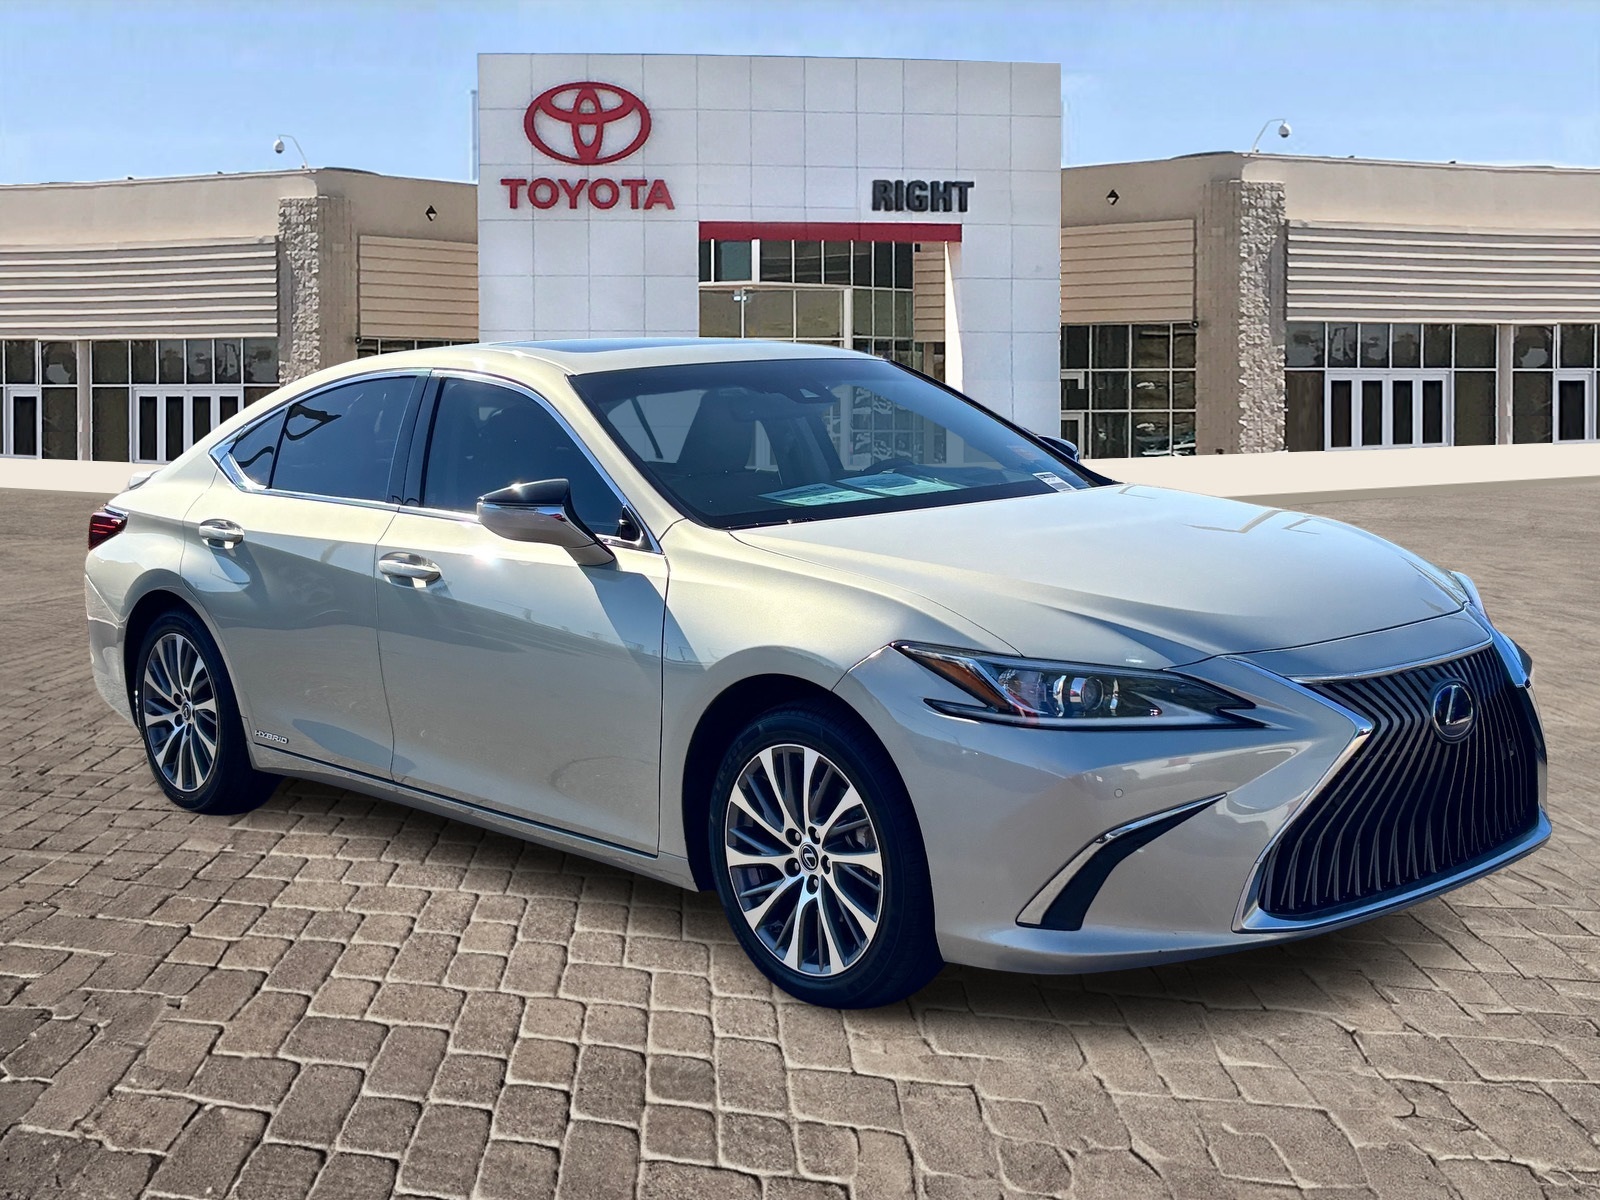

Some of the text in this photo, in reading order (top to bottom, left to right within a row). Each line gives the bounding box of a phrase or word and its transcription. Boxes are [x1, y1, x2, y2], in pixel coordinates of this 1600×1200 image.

[500, 178, 675, 210] TOYOTA
[872, 180, 975, 212] RIGHT
[254, 730, 289, 744] HYBRID
